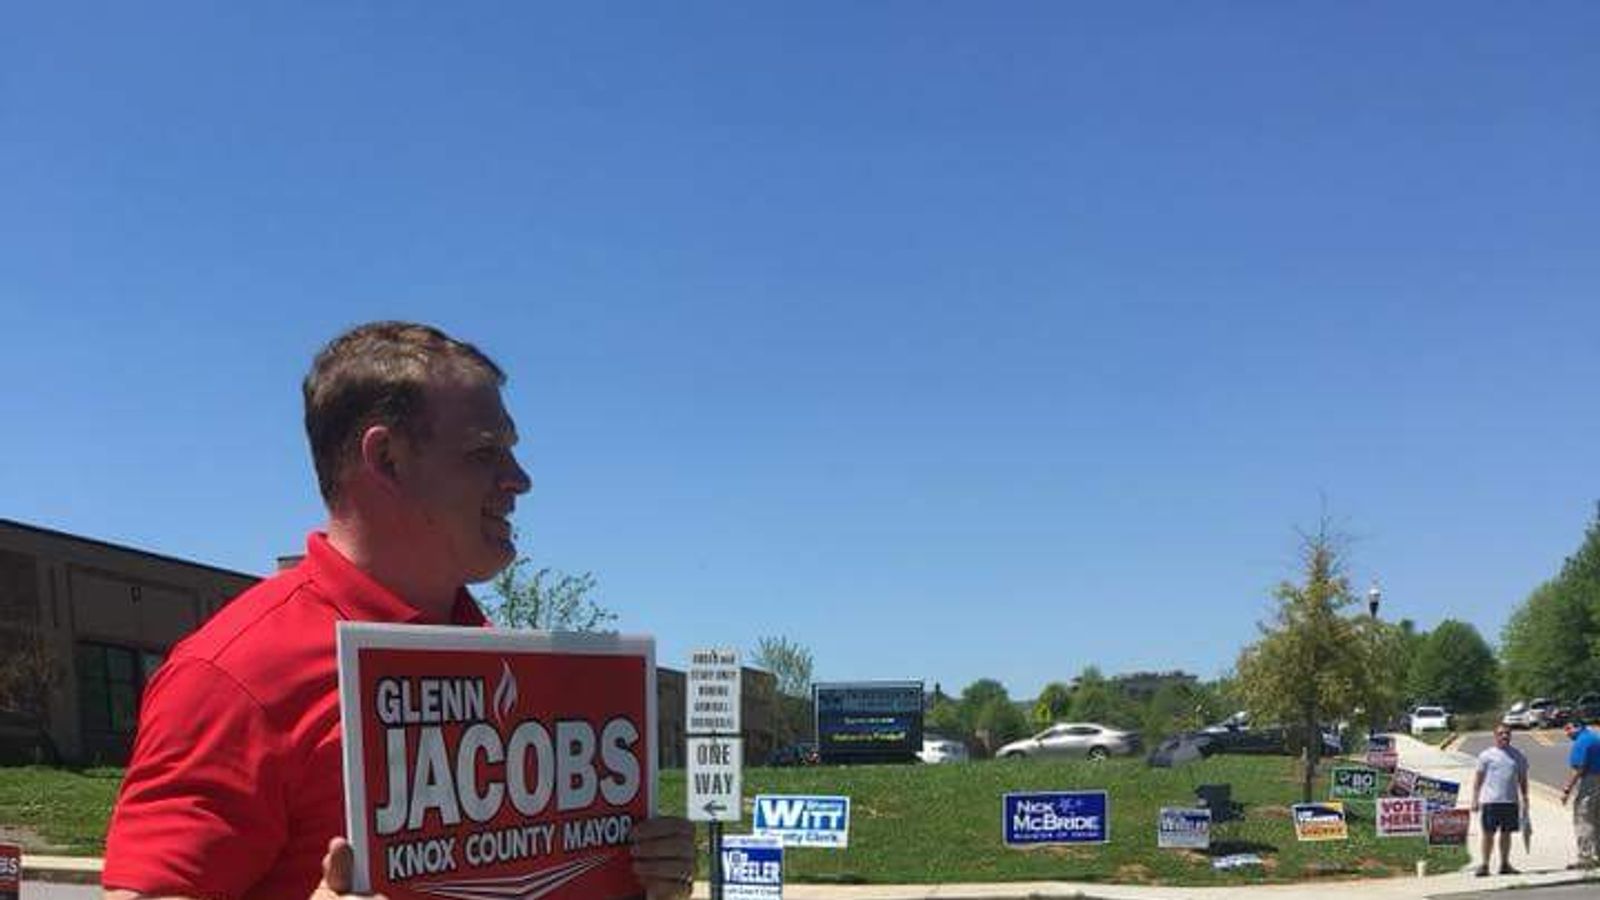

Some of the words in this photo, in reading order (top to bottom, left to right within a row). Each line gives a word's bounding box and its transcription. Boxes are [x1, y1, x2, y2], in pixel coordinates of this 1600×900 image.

[376, 677, 485, 724] GLENN
[697, 745, 731, 765] ONE
[374, 717, 642, 835] JACOBS
[695, 774, 734, 795] WAY
[1381, 801, 1423, 813] VOTE
[1381, 814, 1421, 826] HERE
[387, 839, 457, 881] KNOX
[465, 823, 556, 866] COUNTY
